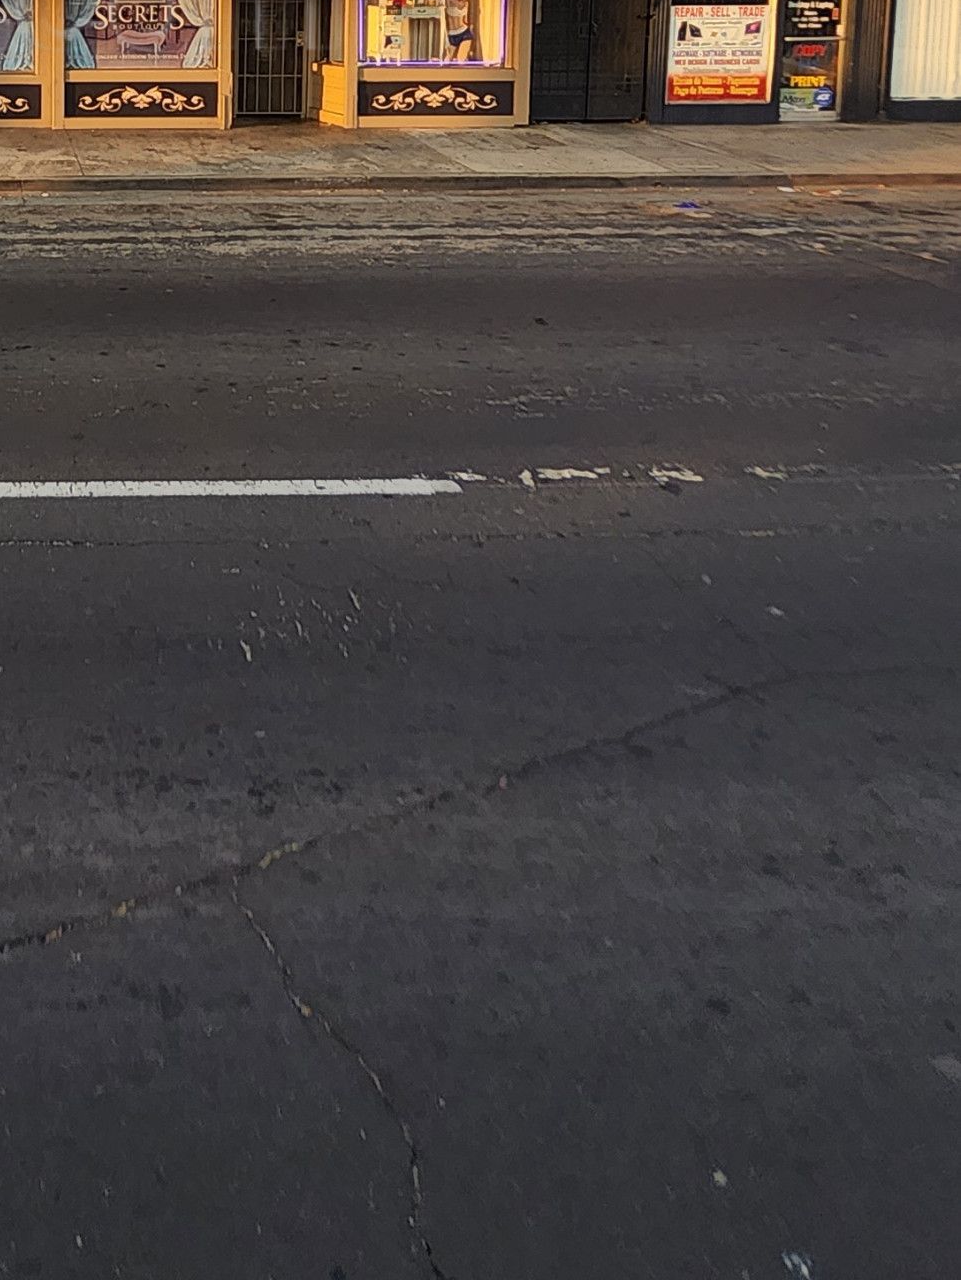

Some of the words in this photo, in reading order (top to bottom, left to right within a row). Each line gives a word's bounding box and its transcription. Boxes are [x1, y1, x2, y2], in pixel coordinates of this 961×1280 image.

[675, 7, 704, 17] REPAIR
[710, 7, 730, 17] SELL
[738, 6, 765, 16] TRADE
[94, 5, 184, 30] SECRETS
[790, 76, 827, 87] PRINT
